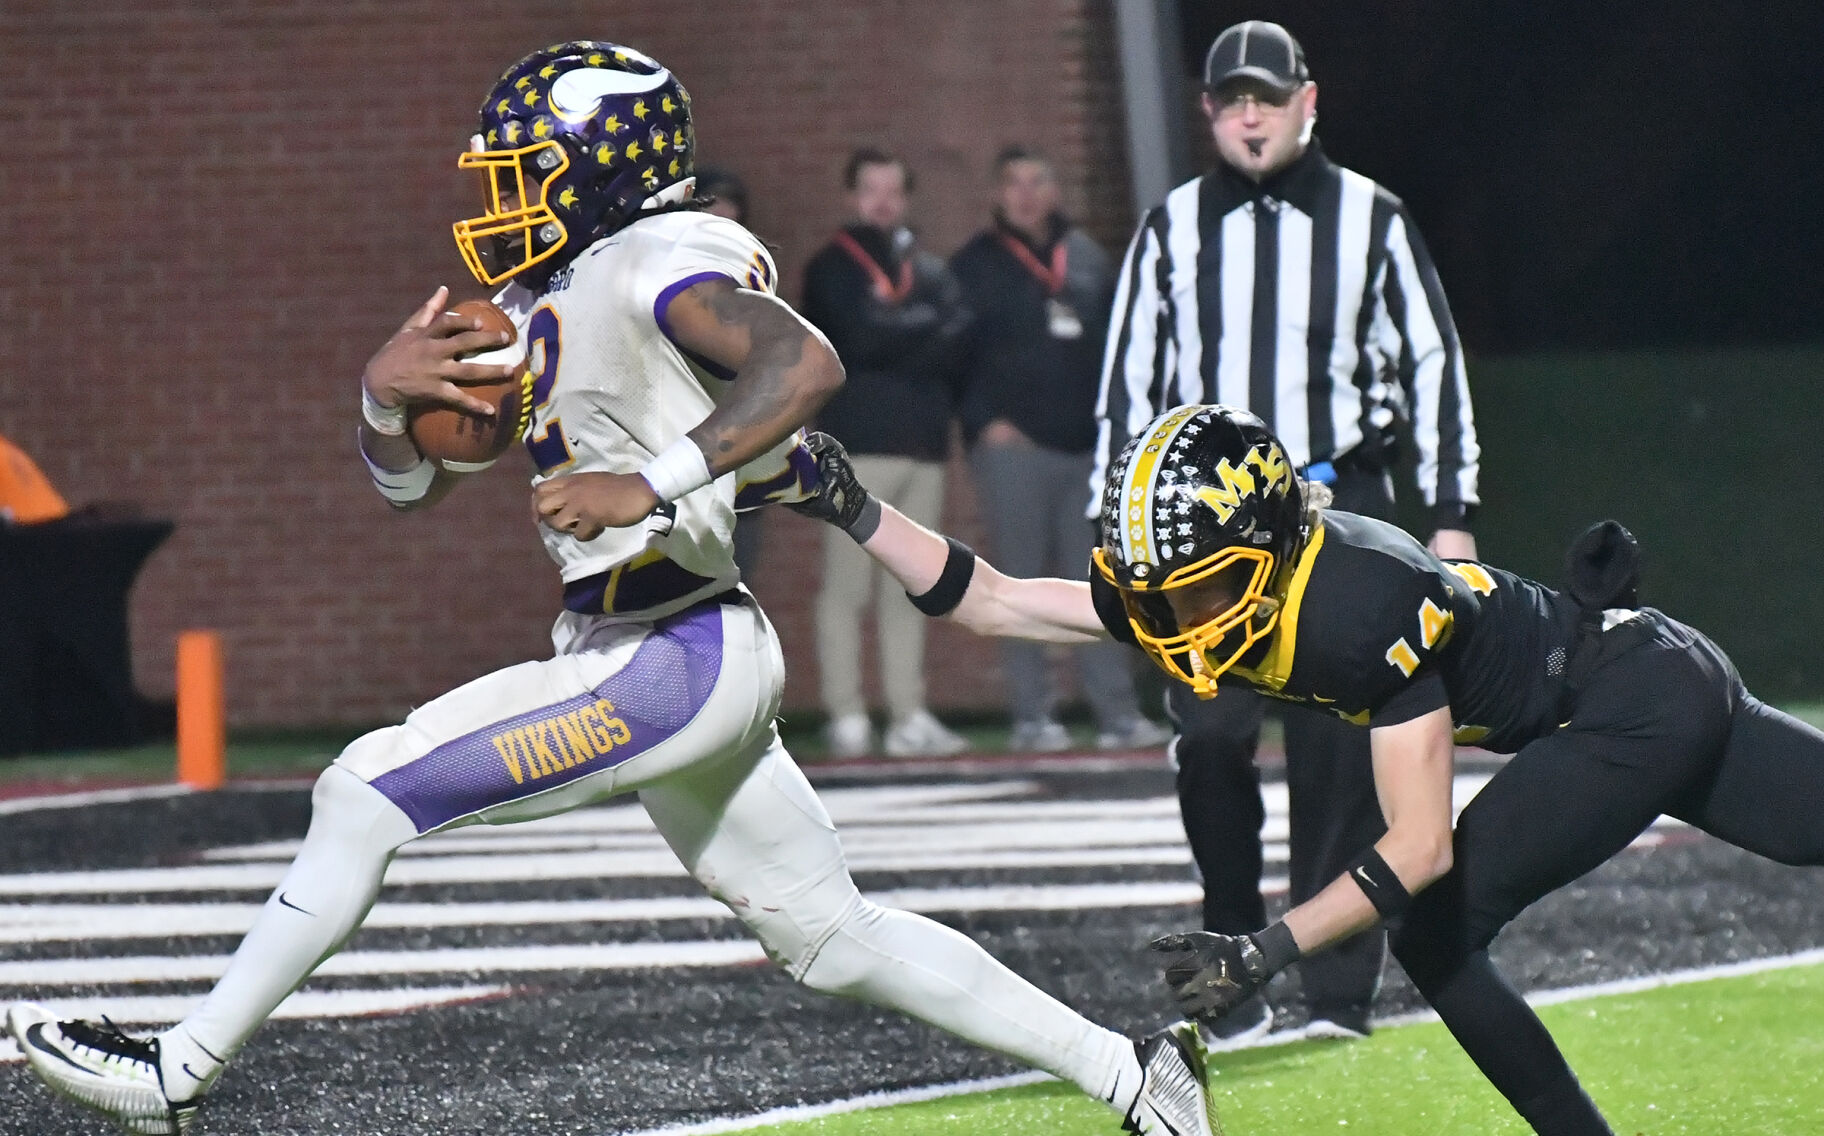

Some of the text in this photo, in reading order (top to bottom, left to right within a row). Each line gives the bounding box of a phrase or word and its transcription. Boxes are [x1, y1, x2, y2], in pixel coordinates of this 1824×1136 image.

[525, 303, 576, 473] 2
[1385, 597, 1454, 679] 14
[492, 699, 632, 784] VIKINGS
